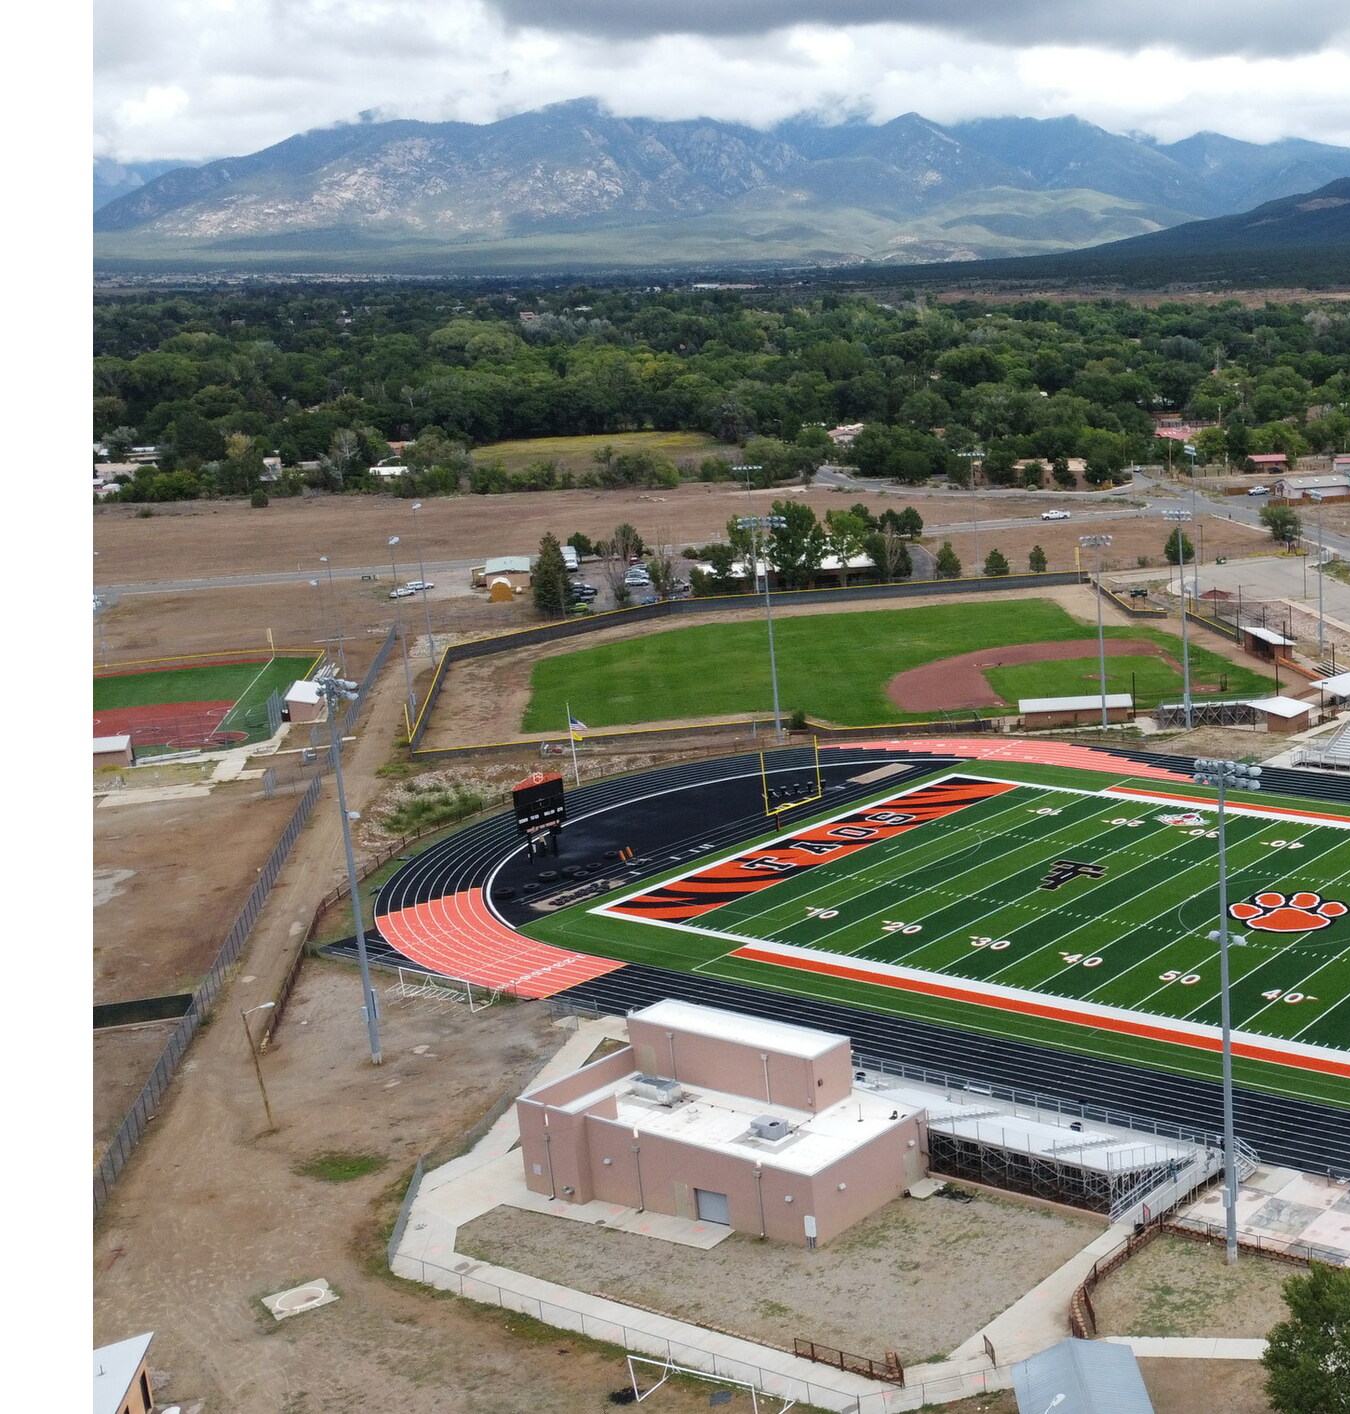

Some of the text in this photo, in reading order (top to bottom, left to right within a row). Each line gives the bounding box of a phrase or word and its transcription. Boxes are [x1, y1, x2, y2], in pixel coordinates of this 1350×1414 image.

[1110, 818, 1146, 828] 20
[740, 811, 917, 872] TAOS
[1270, 839, 1305, 850] 40
[806, 907, 839, 919] 10
[881, 921, 923, 935] 20
[971, 937, 1011, 951] 30
[1062, 953, 1103, 968] 40
[1158, 970, 1201, 985] 50
[1261, 988, 1305, 1004] 40
